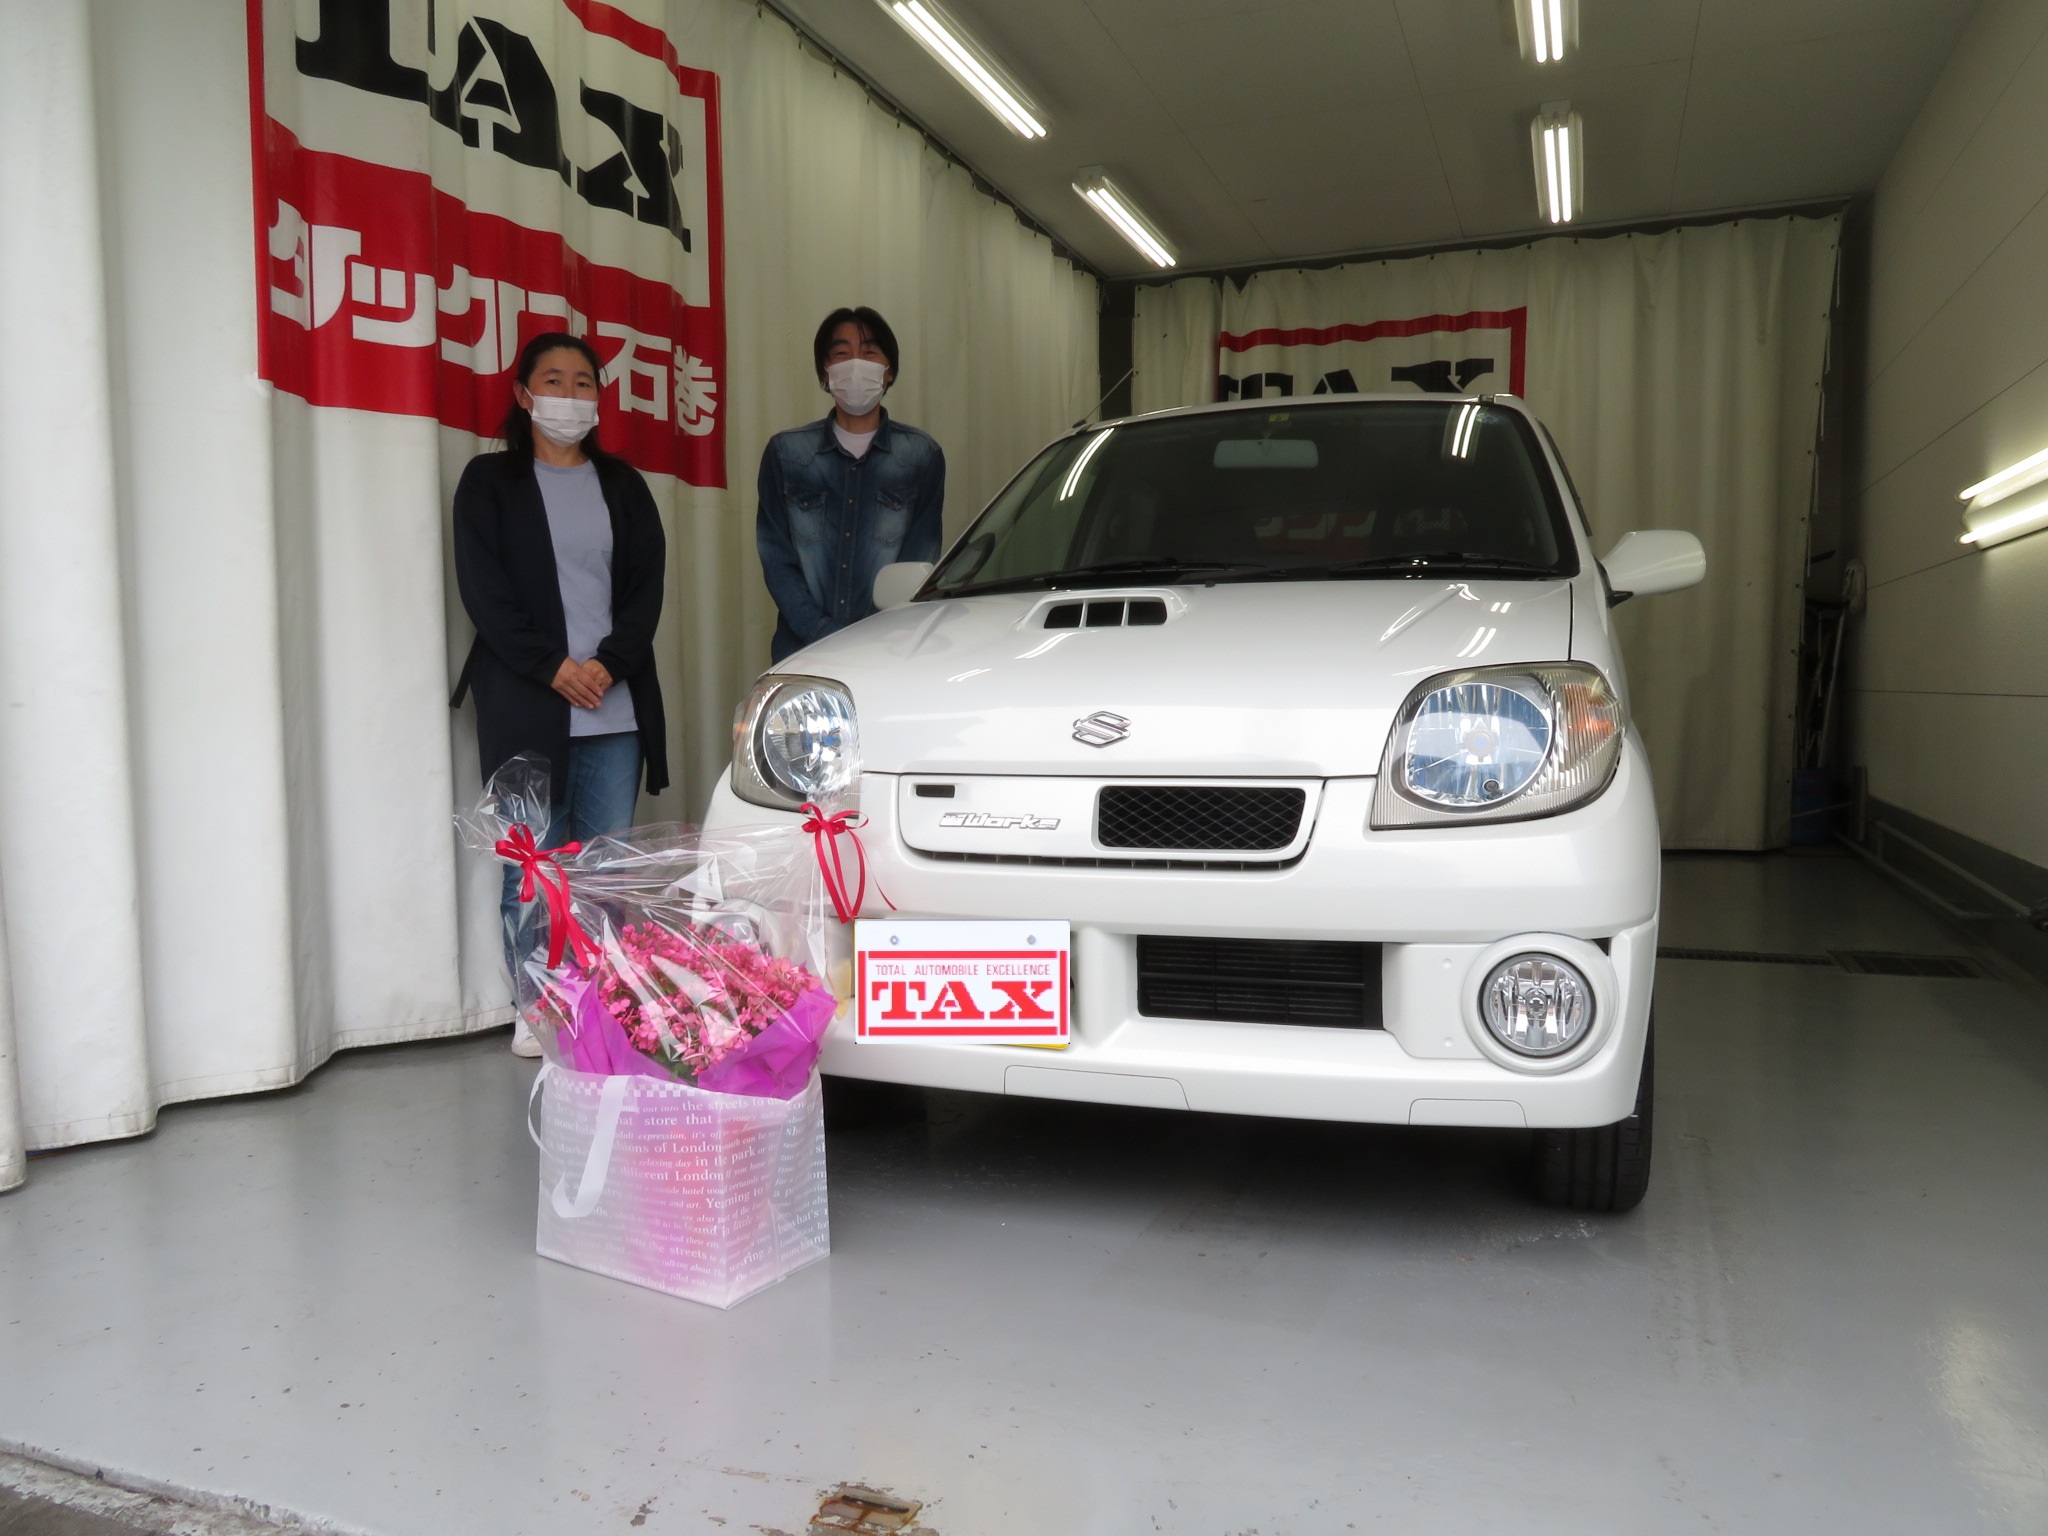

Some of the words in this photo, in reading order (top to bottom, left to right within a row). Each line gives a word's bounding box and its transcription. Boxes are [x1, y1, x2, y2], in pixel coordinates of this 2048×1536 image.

[875, 964, 907, 976] TOTAL
[914, 964, 979, 976] AUTOMOBILE
[986, 964, 1050, 976] EXCELLENCE
[871, 980, 1055, 1020] TAX
[660, 1104, 680, 1112] into
[682, 1100, 704, 1112] the
[707, 1099, 749, 1112] streets
[644, 1115, 678, 1126] store
[686, 1112, 713, 1125] that
[637, 1131, 687, 1142] expression,
[690, 1129, 706, 1140] it's
[654, 1142, 668, 1154] of
[671, 1141, 723, 1154] London
[675, 1159, 692, 1170] day
[695, 1155, 709, 1168] in
[731, 1145, 756, 1167] park
[674, 1169, 725, 1182] London
[682, 1185, 705, 1196] hotel
[752, 1187, 765, 1199] to
[696, 1214, 717, 1223] also
[668, 1245, 708, 1262] streets
